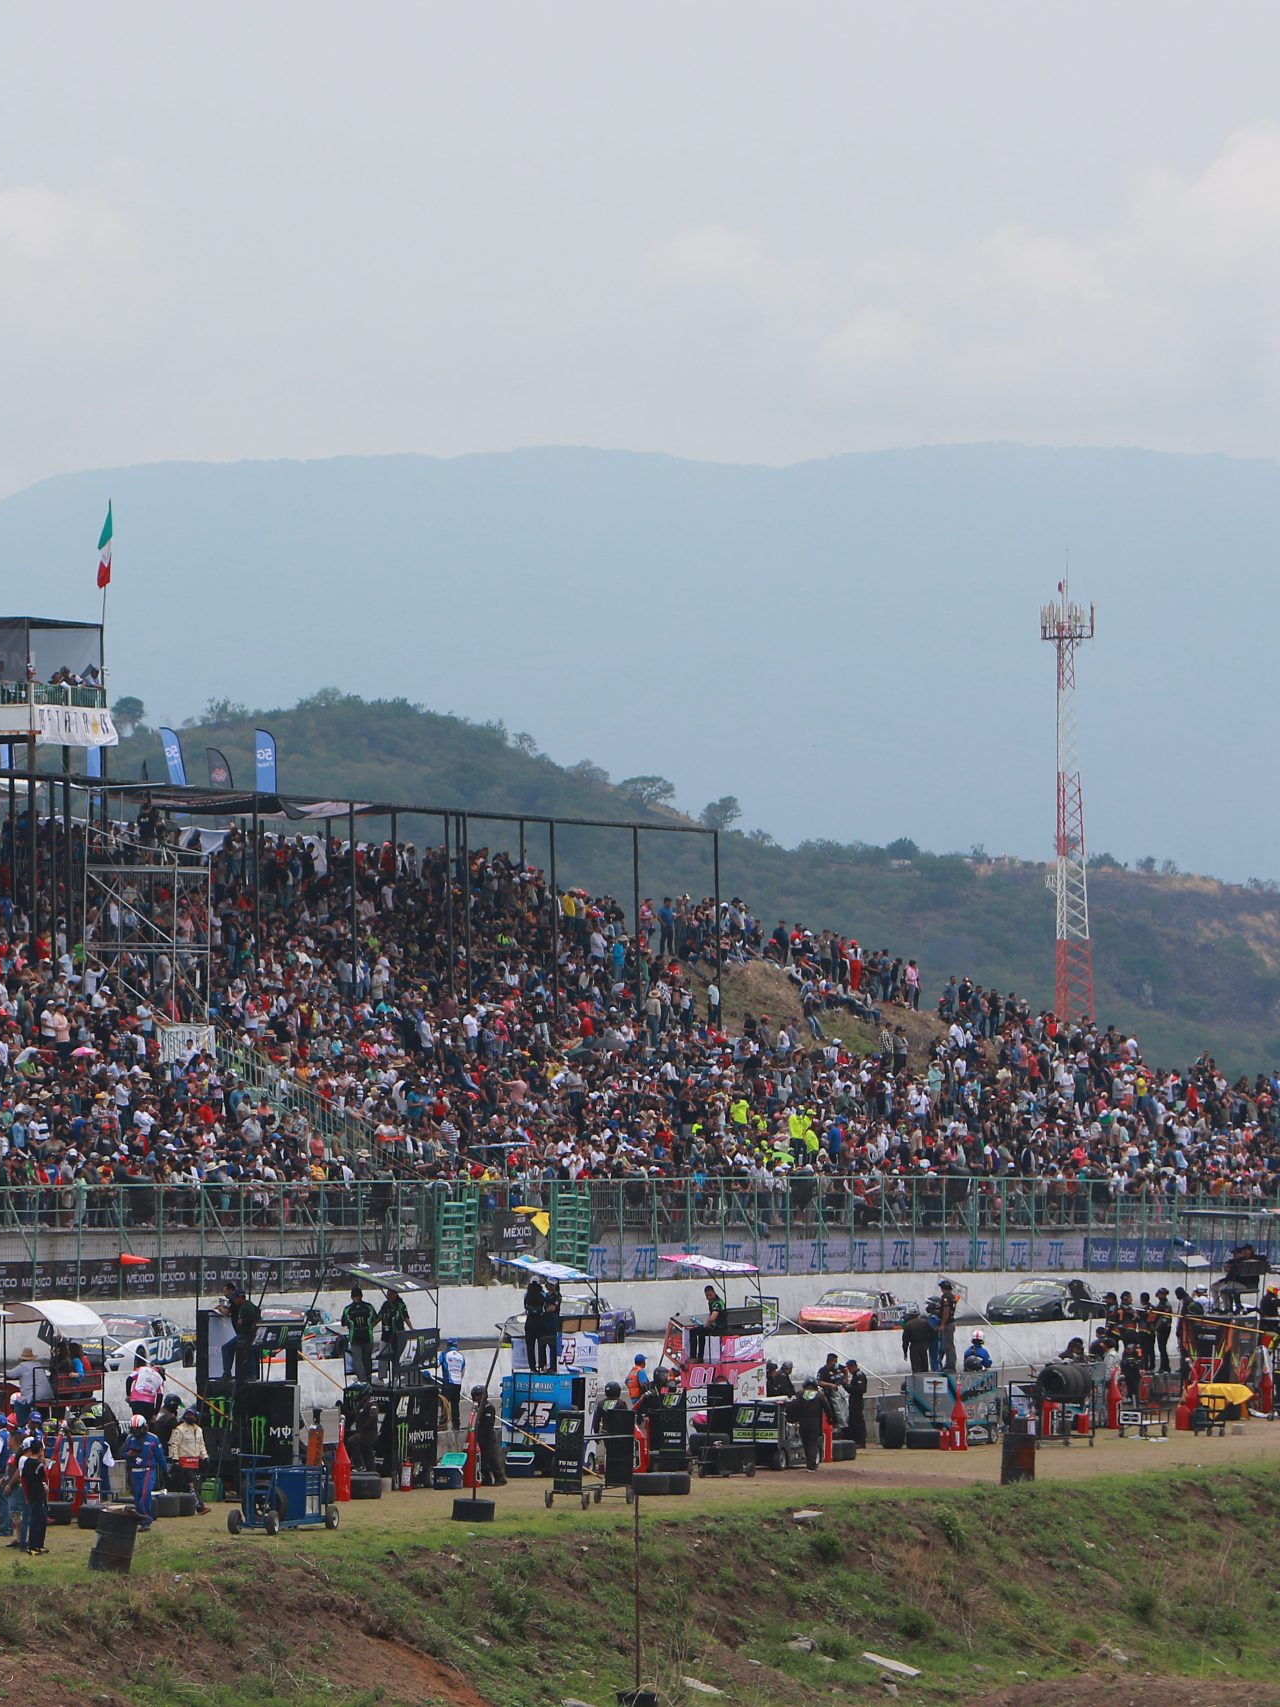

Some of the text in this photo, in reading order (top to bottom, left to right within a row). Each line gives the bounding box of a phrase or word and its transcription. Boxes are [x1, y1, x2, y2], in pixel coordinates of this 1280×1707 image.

[503, 1223, 532, 1239] MÉXICO
[767, 1243, 785, 1270] ZTE
[892, 1240, 909, 1266] ZTE
[1010, 1241, 1027, 1266] ZTE
[1048, 1241, 1064, 1266] ZTE
[56, 1275, 87, 1286] MÉXIO
[157, 1338, 174, 1361] 08
[686, 1393, 707, 1405] kote
